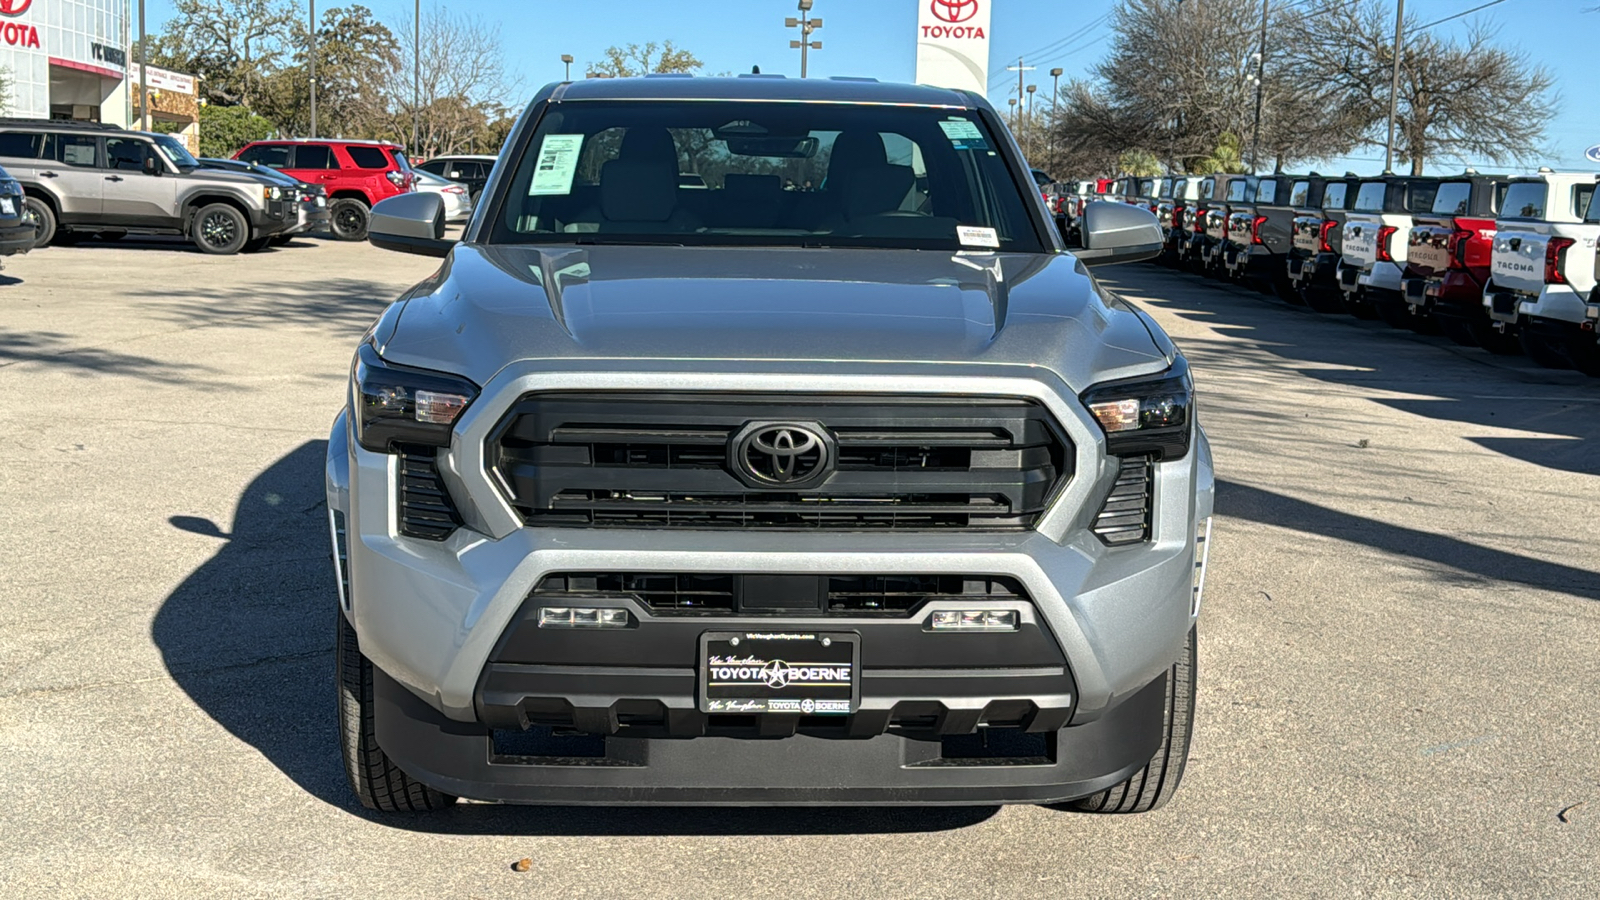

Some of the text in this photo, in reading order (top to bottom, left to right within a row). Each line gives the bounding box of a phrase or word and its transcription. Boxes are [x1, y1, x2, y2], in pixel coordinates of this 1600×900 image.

[921, 25, 985, 39] TOYOTA
[1345, 244, 1370, 253] TACOMA
[1410, 251, 1439, 262] TACOMA
[1497, 261, 1534, 273] TACOMA
[708, 654, 765, 667] Vic Vaughan
[710, 667, 851, 681] TOYOTA BOERNE
[708, 699, 850, 712] Vic Vaughan TOYOTA BOERNE
